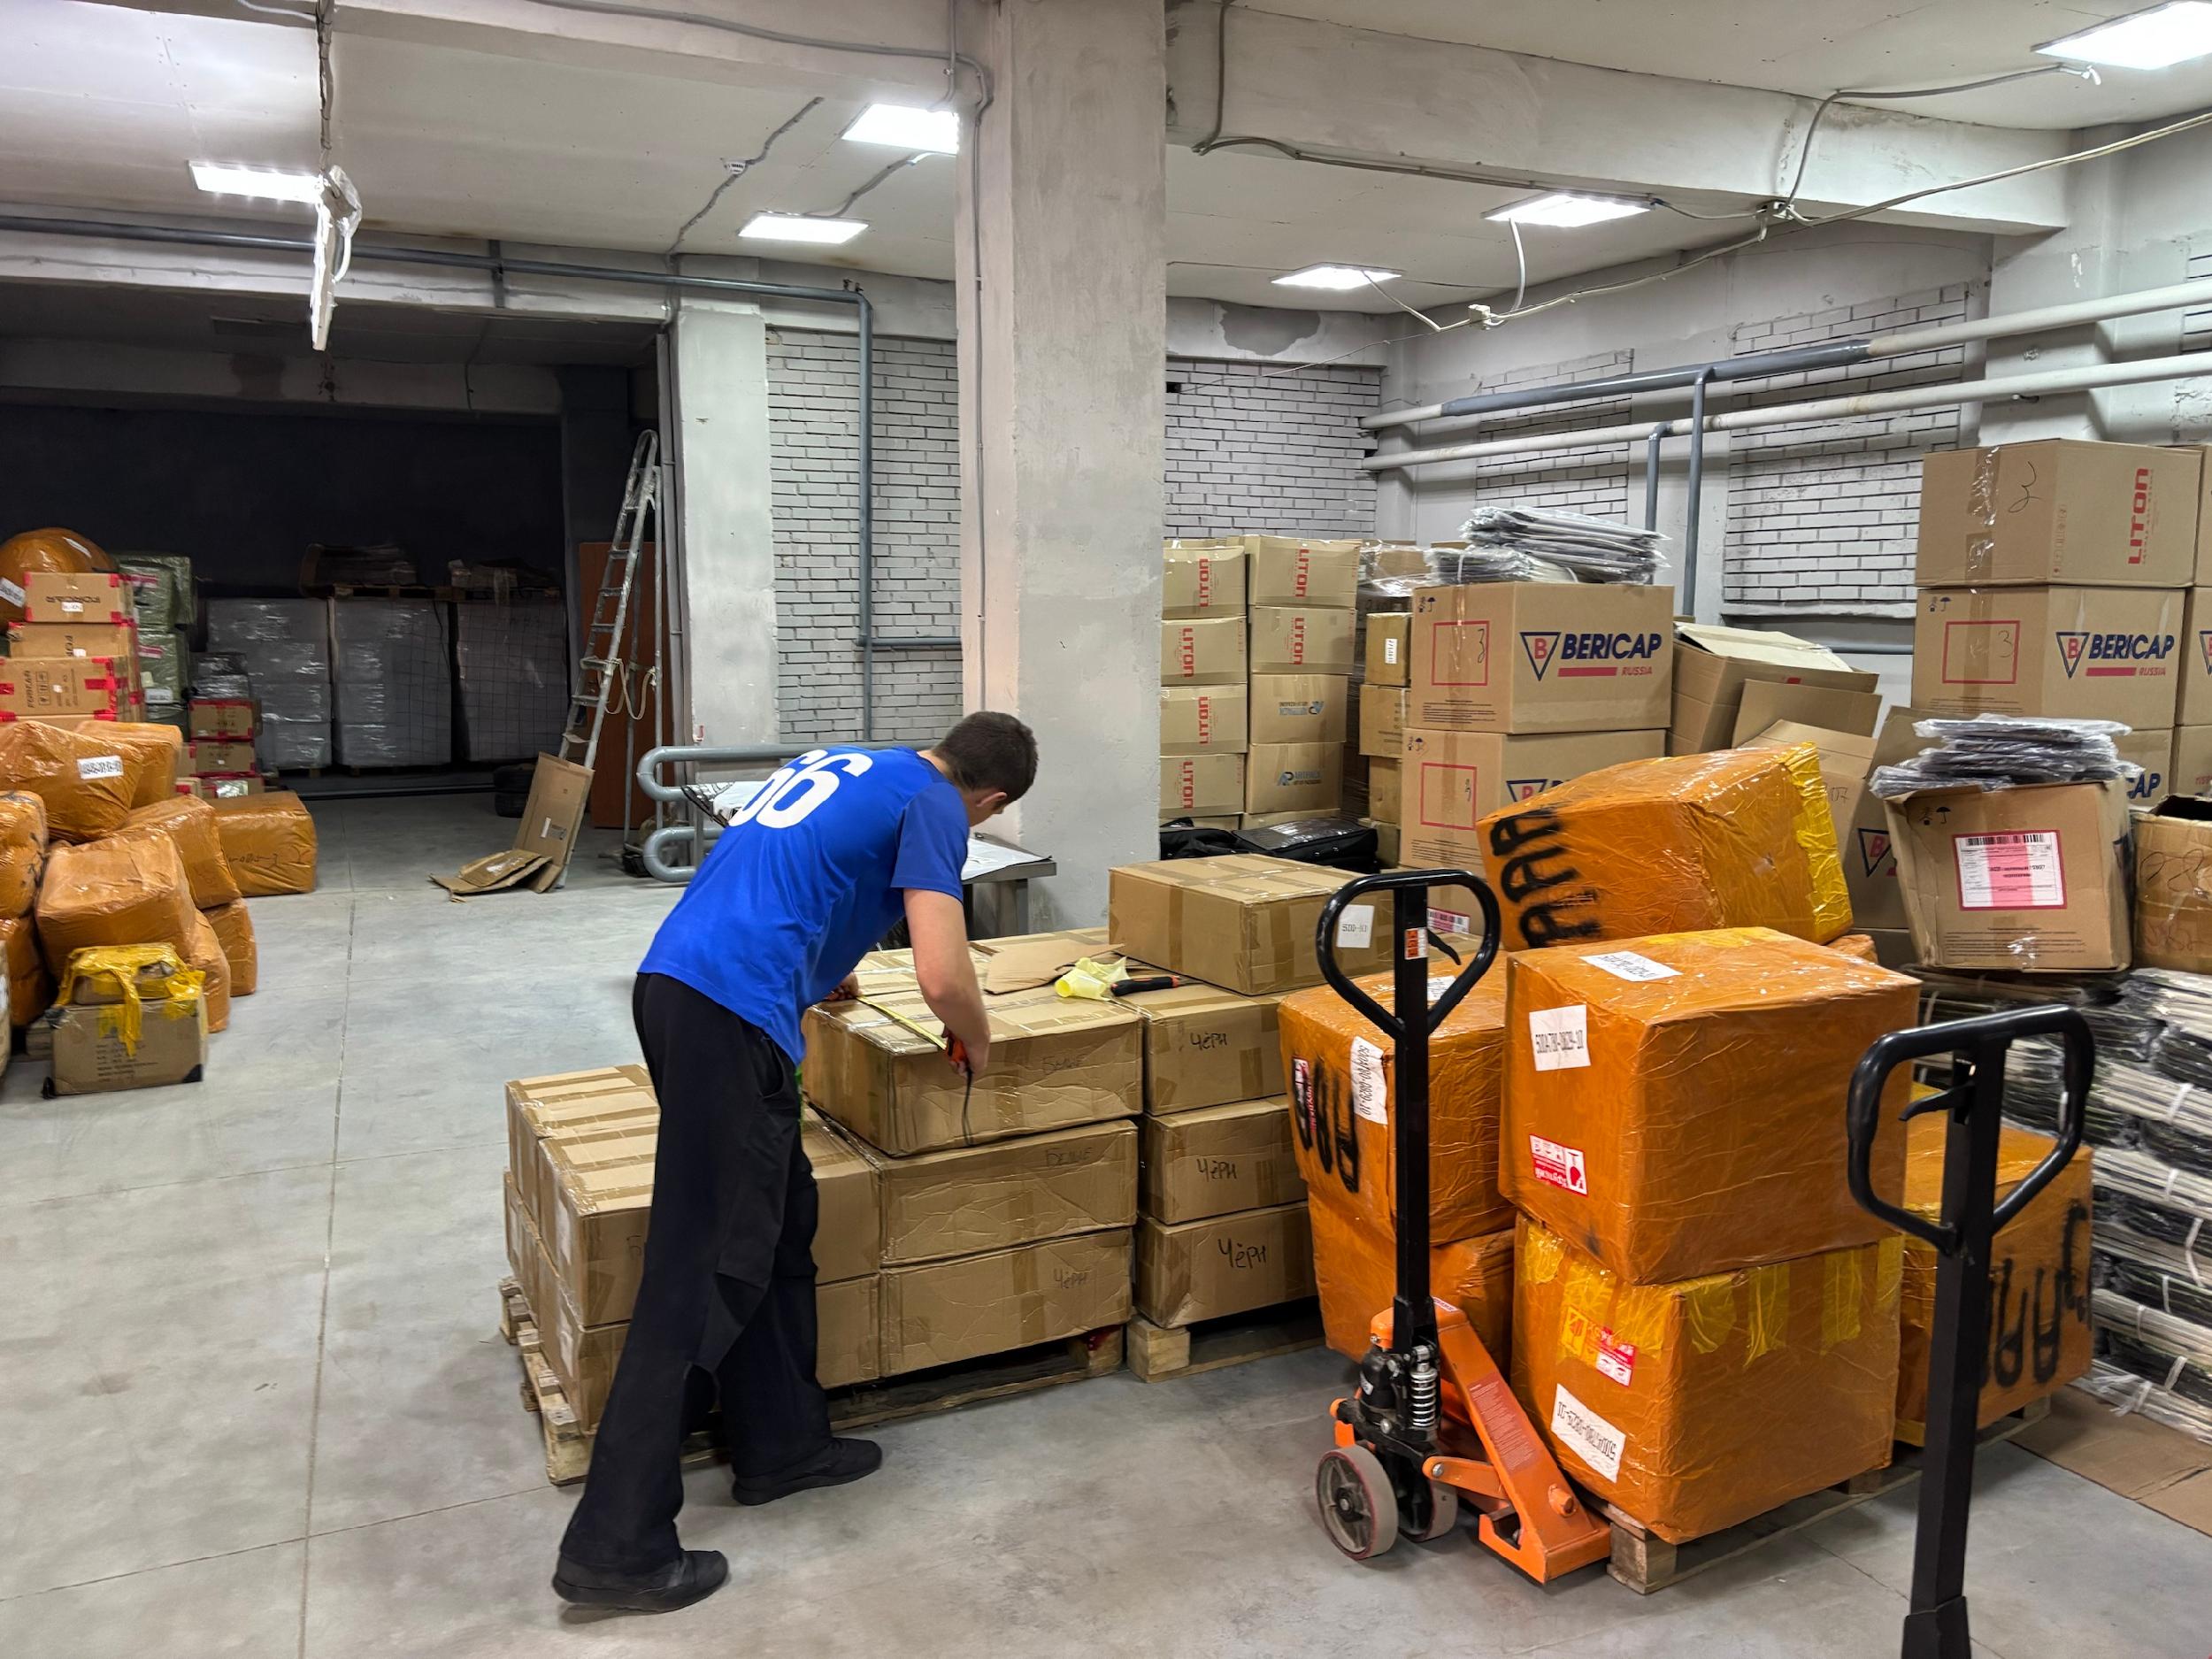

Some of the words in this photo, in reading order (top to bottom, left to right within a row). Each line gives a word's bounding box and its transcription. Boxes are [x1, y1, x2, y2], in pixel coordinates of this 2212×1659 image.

[1561, 633, 1663, 660] BERICAP
[2088, 634, 2175, 659] BERICAP
[1621, 665, 1653, 676] RUSSIA
[2139, 666, 2166, 677] RUSSIA
